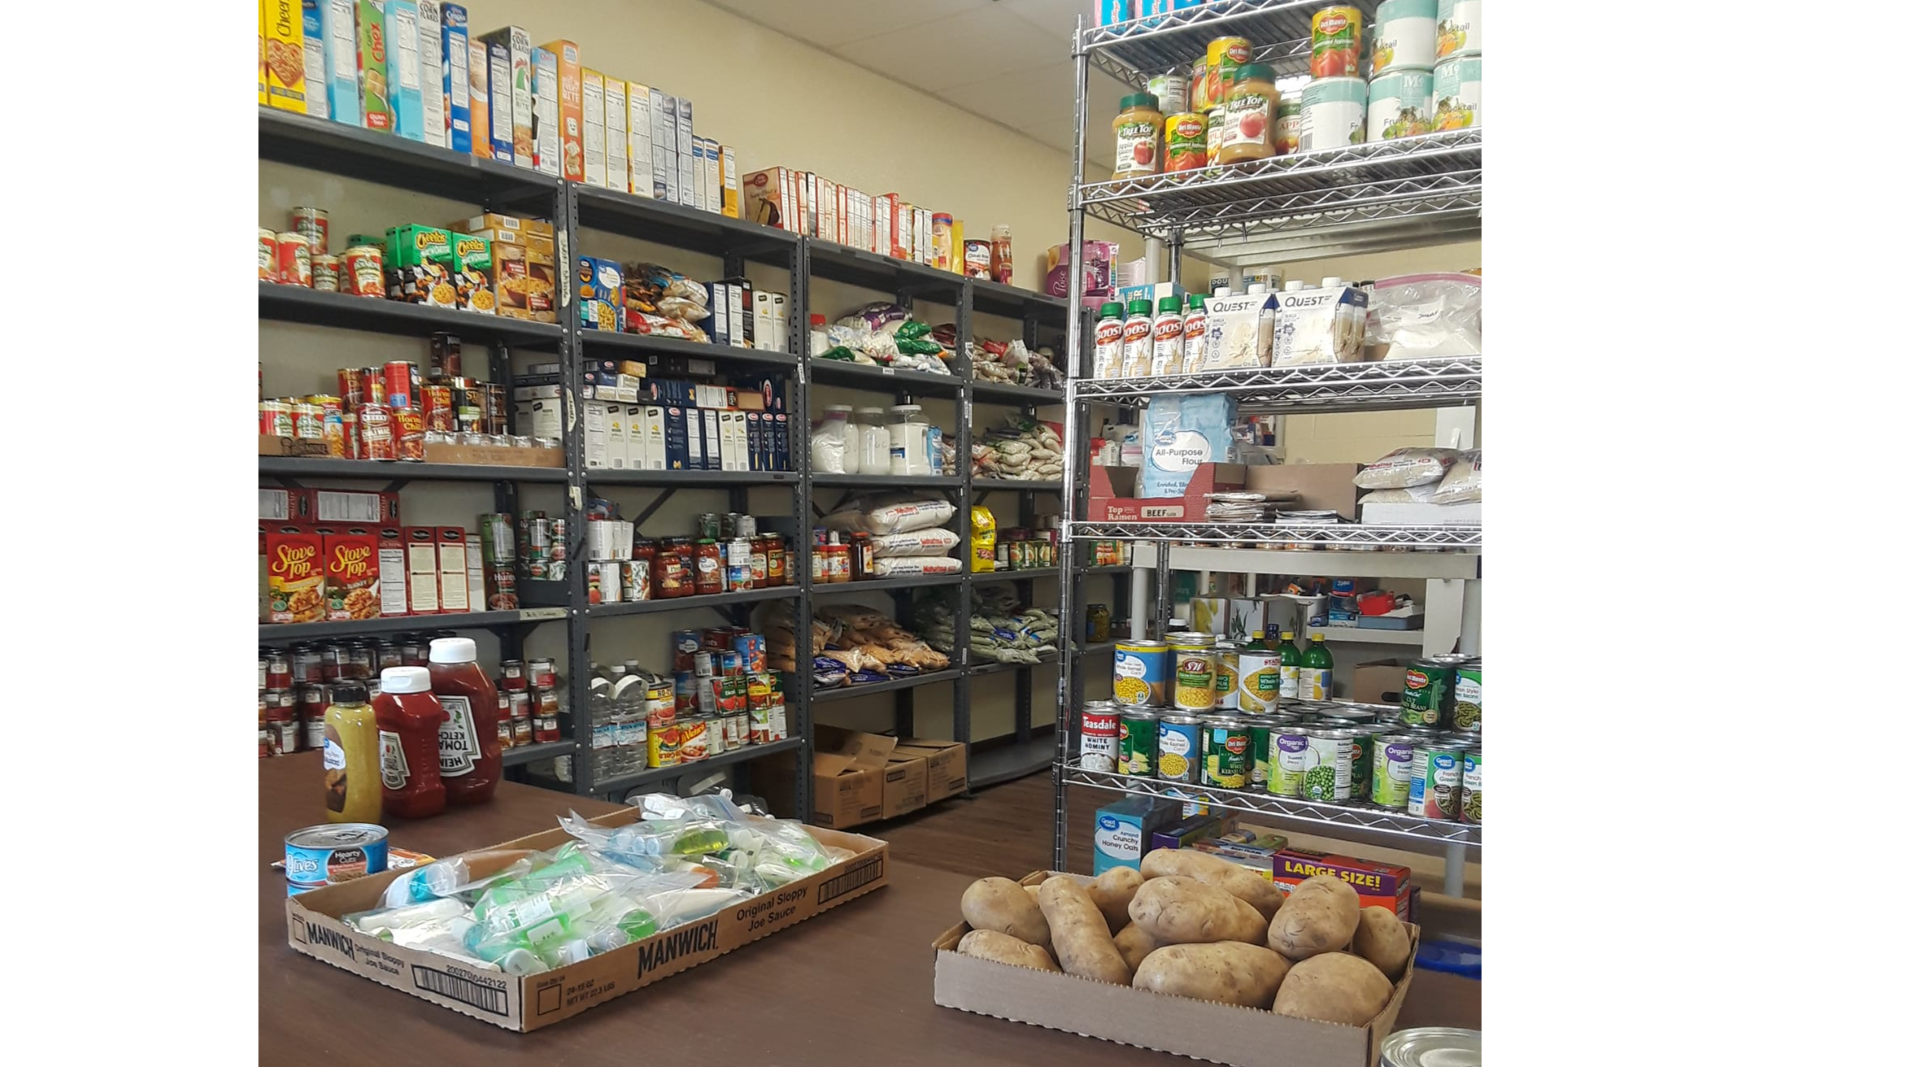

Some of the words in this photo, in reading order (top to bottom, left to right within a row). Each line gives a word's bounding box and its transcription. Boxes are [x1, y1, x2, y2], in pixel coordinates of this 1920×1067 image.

[370, 22, 385, 63] Chex
[1246, 95, 1264, 105] TOP
[416, 231, 446, 249] Cheetos
[456, 238, 486, 256] Cheetos
[1052, 271, 1067, 295] Poise
[1212, 301, 1250, 313] QUEST
[1284, 296, 1325, 308] QUEST
[1155, 448, 1203, 458] All-Purpose
[1106, 506, 1124, 514] Top
[1146, 509, 1167, 517] BEEF
[271, 544, 316, 573] Stove
[330, 544, 372, 573] Stove
[288, 561, 311, 579] Top
[345, 561, 367, 579] Top
[1082, 716, 1117, 730] Teasdale
[1084, 743, 1111, 751] HOMINY
[1279, 738, 1305, 748] Organic
[1387, 747, 1413, 757] Organi
[1112, 834, 1139, 846] Crunchy
[1120, 831, 1139, 839] Almond
[1101, 839, 1123, 850] Honey
[1123, 843, 1139, 852] Oats
[335, 850, 361, 860] Hearty
[1285, 860, 1336, 877] LARGE
[1340, 870, 1381, 888] SIZE!
[736, 896, 775, 922] Original
[776, 885, 808, 906] Sloppy
[747, 917, 765, 932] Joe
[768, 904, 797, 923] Sauce
[306, 920, 357, 961] MANWICH
[354, 943, 381, 959] Original
[637, 919, 718, 980] MANWICH
[365, 957, 378, 968] Joe
[378, 961, 400, 976] Sauce
